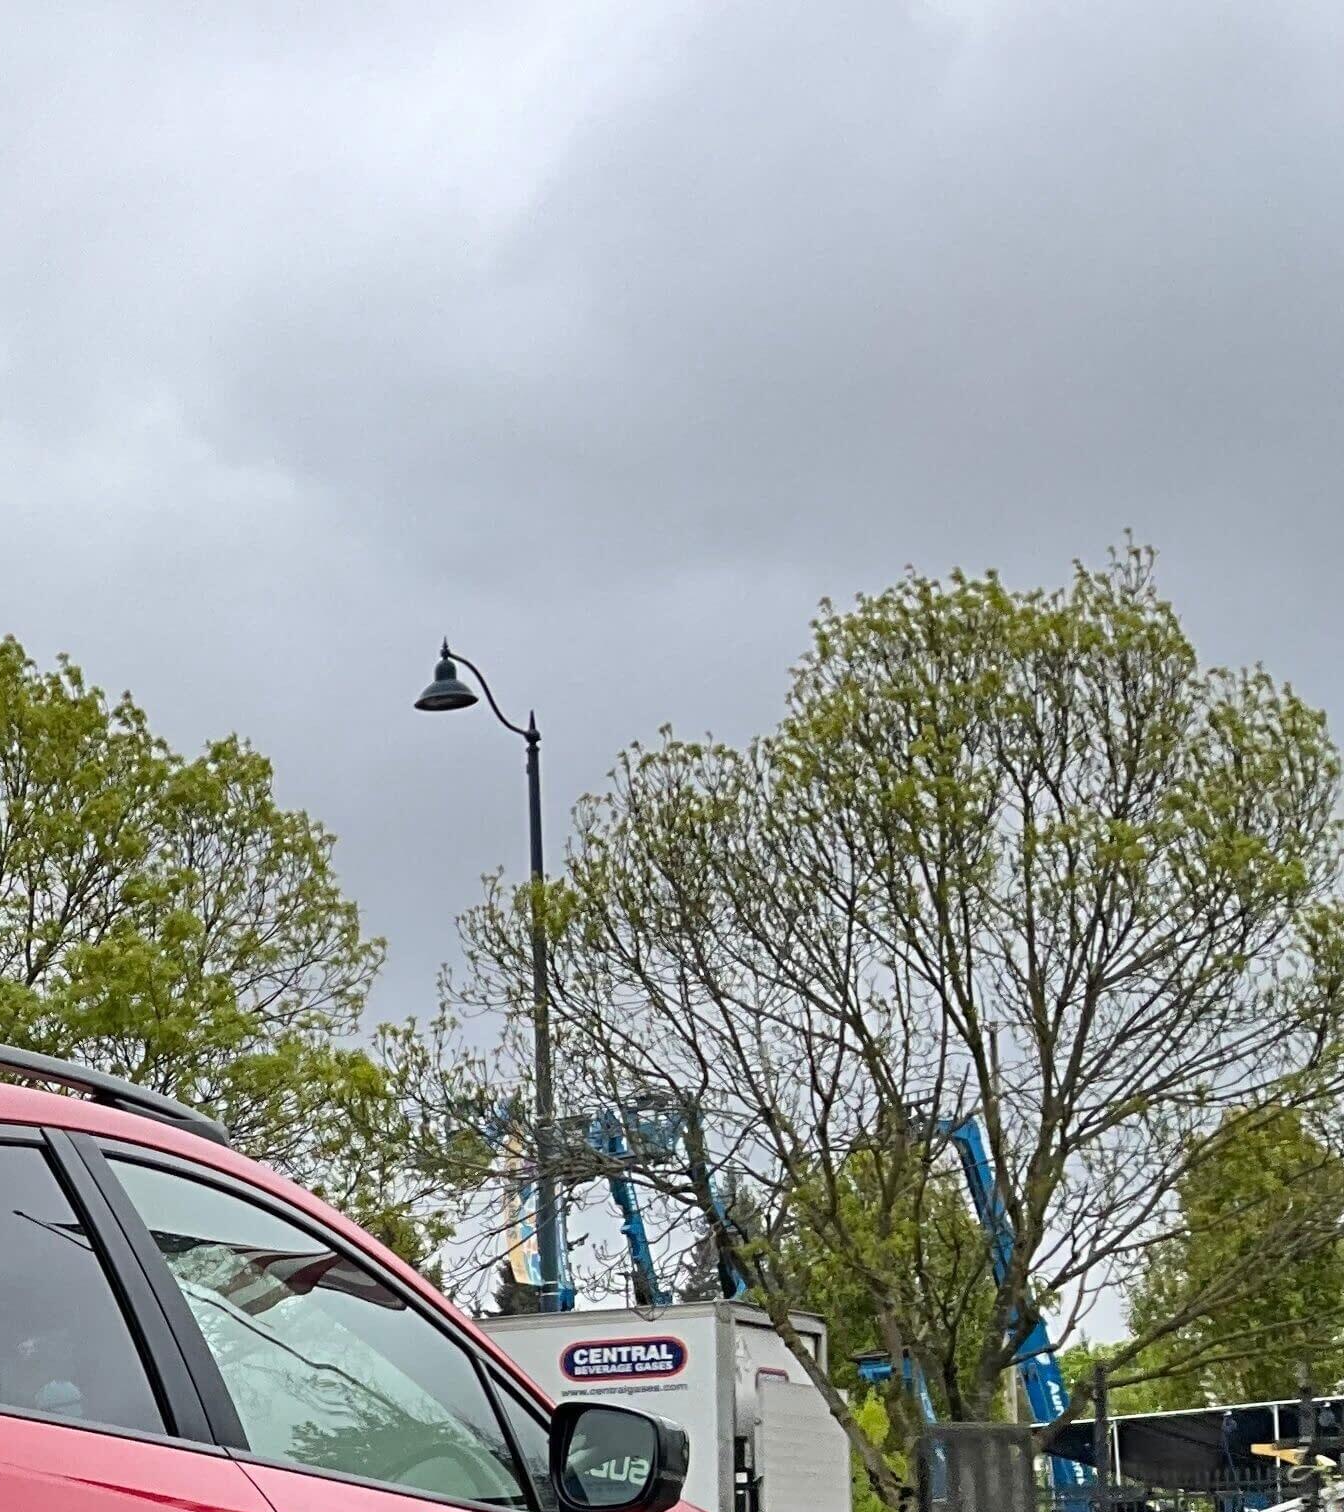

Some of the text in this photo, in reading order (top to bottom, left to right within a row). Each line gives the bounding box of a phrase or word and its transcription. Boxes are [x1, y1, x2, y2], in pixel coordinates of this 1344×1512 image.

[574, 1344, 673, 1364] CENTRAL
[574, 1361, 673, 1375] BEVERAGE GASES
